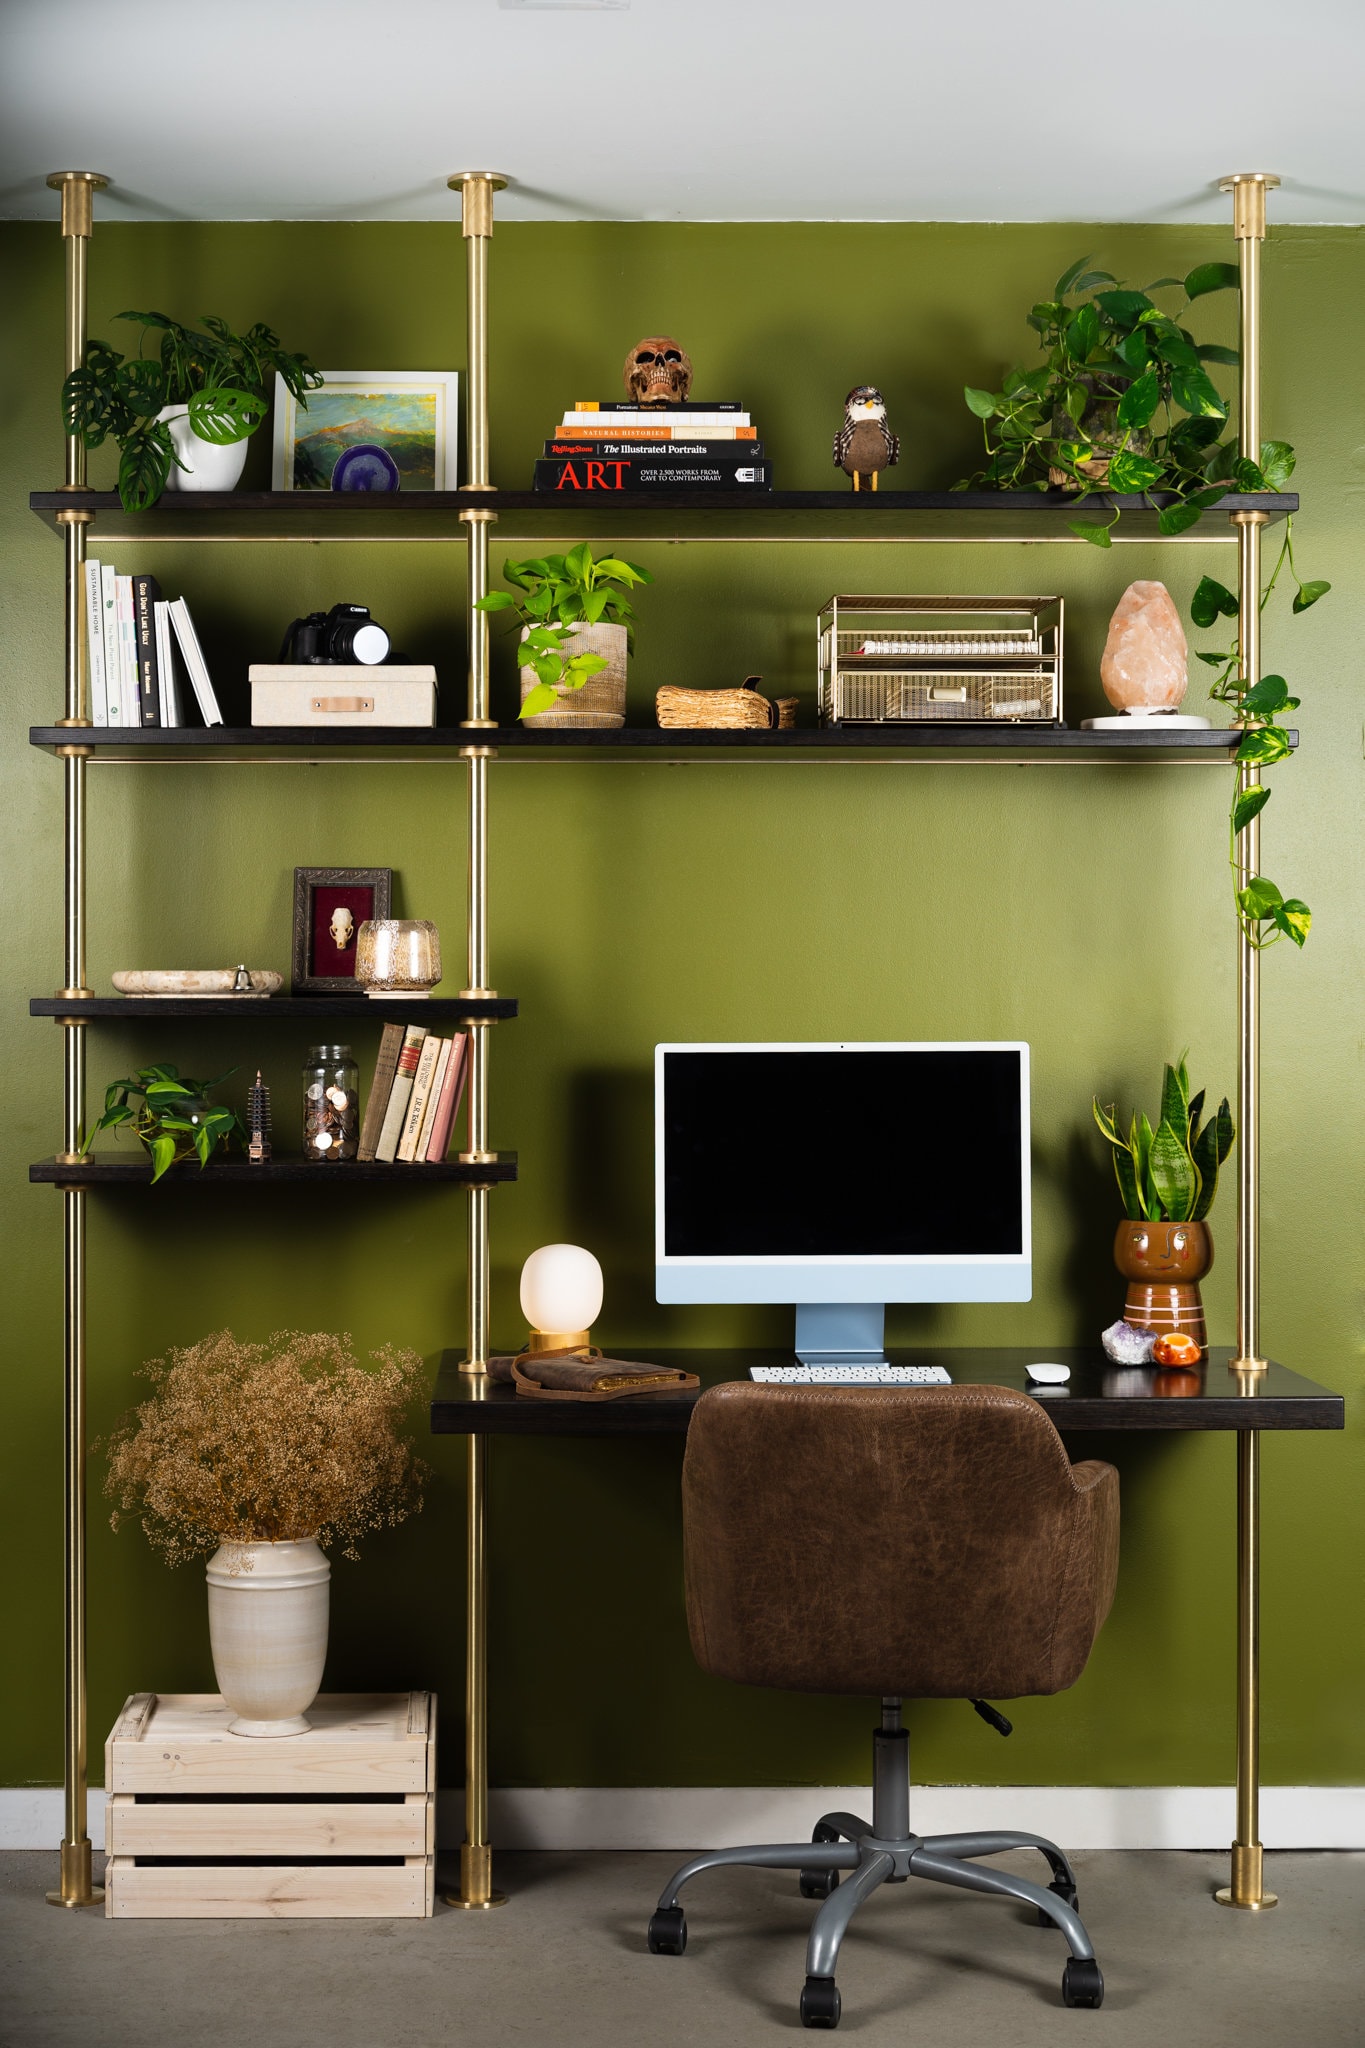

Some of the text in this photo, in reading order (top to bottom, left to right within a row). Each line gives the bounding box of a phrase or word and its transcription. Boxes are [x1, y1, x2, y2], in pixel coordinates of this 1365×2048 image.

[603, 445, 707, 454] The Illustrated Portraits
[554, 460, 631, 490] ART
[91, 569, 99, 612] SUSTAINABLE
[139, 583, 147, 596] GOD
[140, 596, 148, 615] DON'T
[422, 1062, 432, 1089] FELLOWSHIP
[408, 1112, 419, 1134] Tolkien
